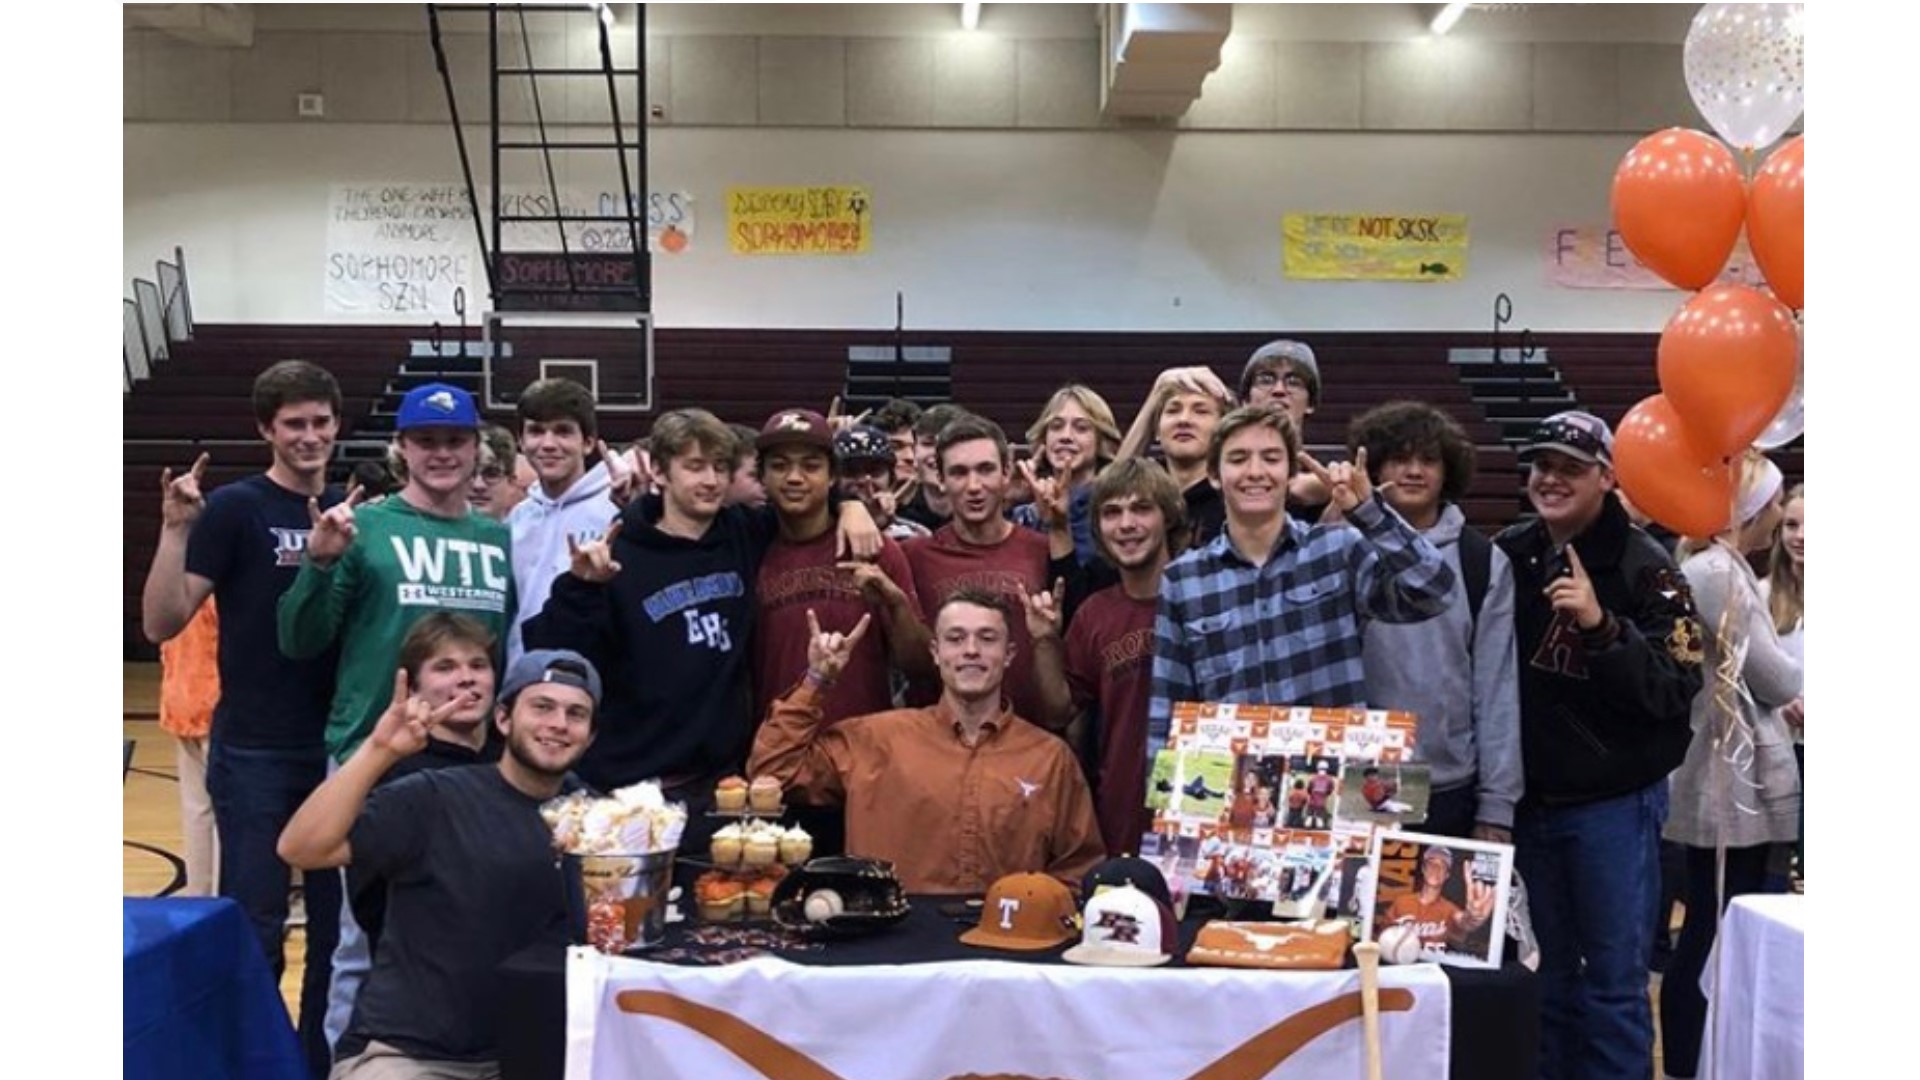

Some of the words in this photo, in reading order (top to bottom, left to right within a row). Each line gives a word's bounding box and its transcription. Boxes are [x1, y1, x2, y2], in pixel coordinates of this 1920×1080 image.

[598, 191, 686, 225] CLSS
[1358, 217, 1393, 238] NOT
[328, 252, 468, 284] SOPHOMORE
[378, 281, 429, 312] SZN
[389, 533, 508, 592] WTC
[998, 897, 1020, 930] T
